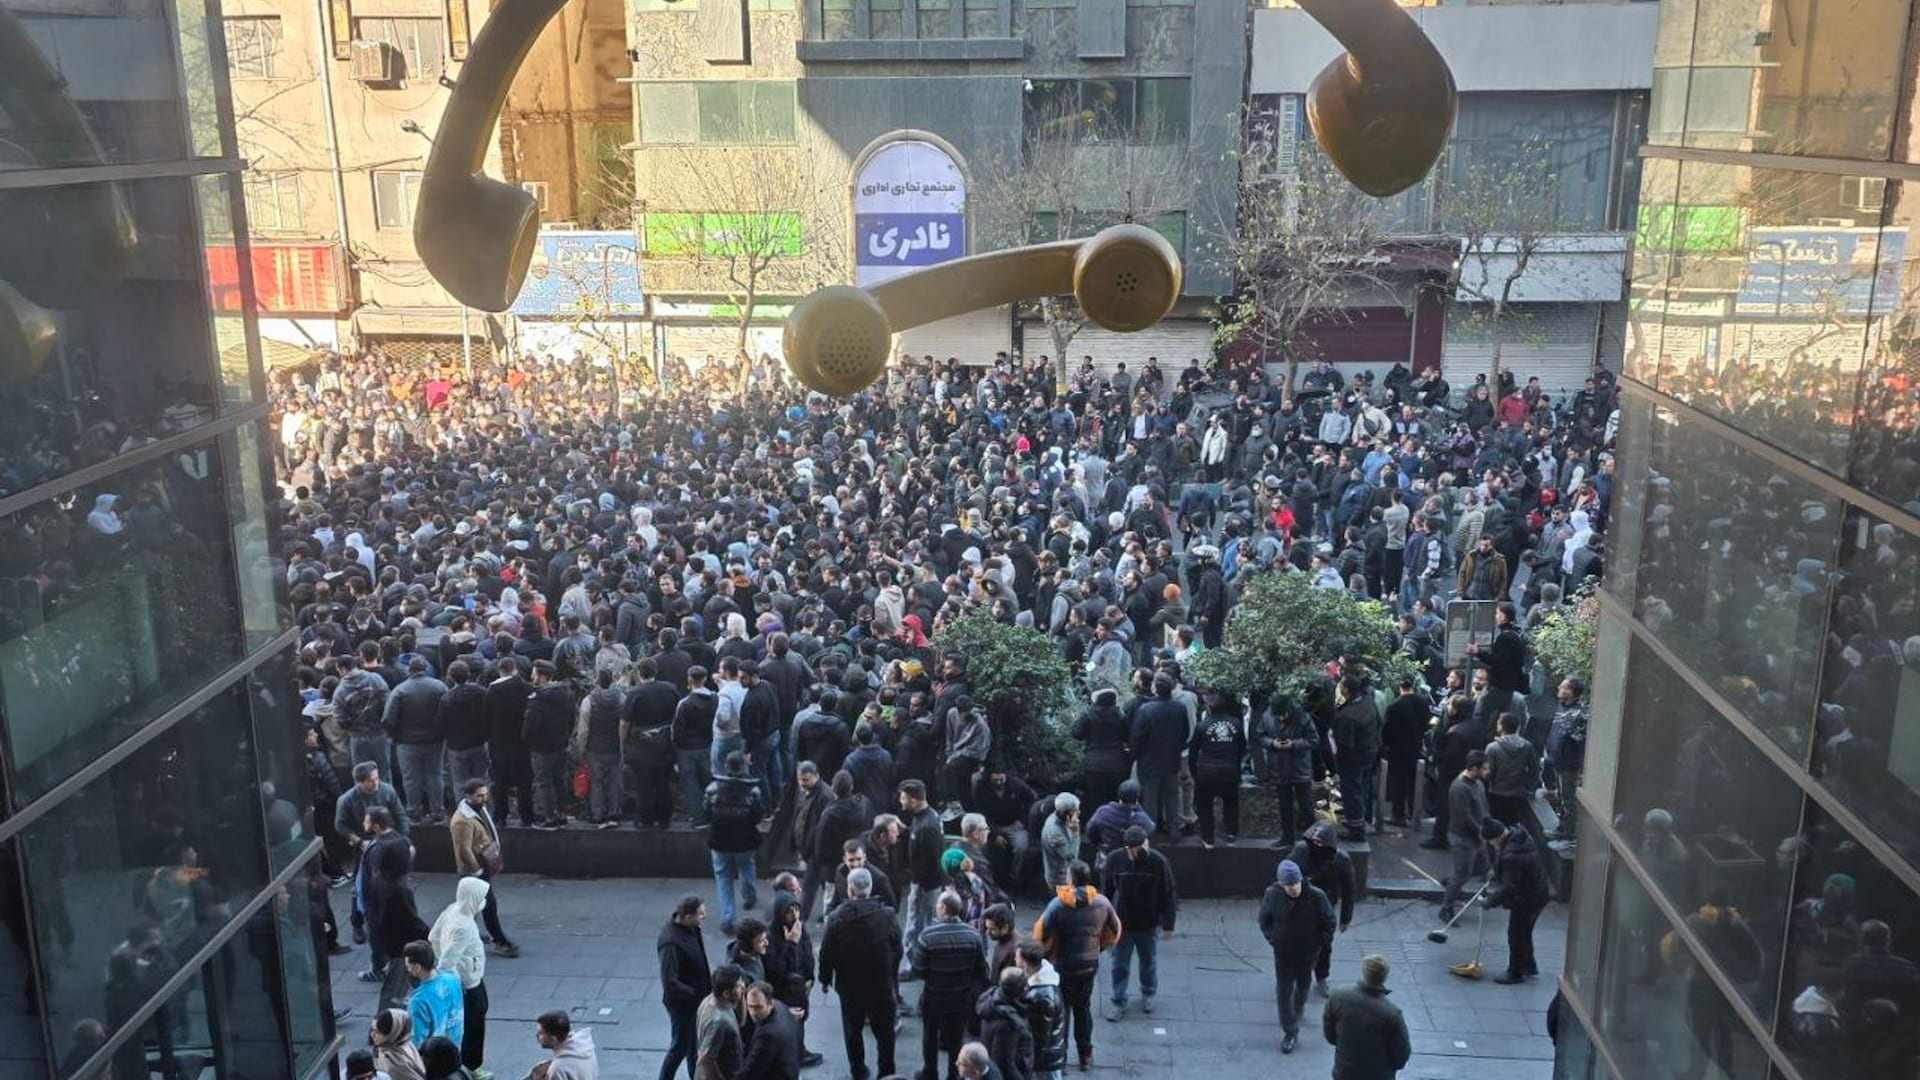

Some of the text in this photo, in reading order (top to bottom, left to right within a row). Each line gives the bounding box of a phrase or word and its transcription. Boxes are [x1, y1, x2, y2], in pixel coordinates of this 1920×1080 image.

[862, 181, 956, 196] مجتمع تجاری اداری
[869, 221, 950, 261] نادری
